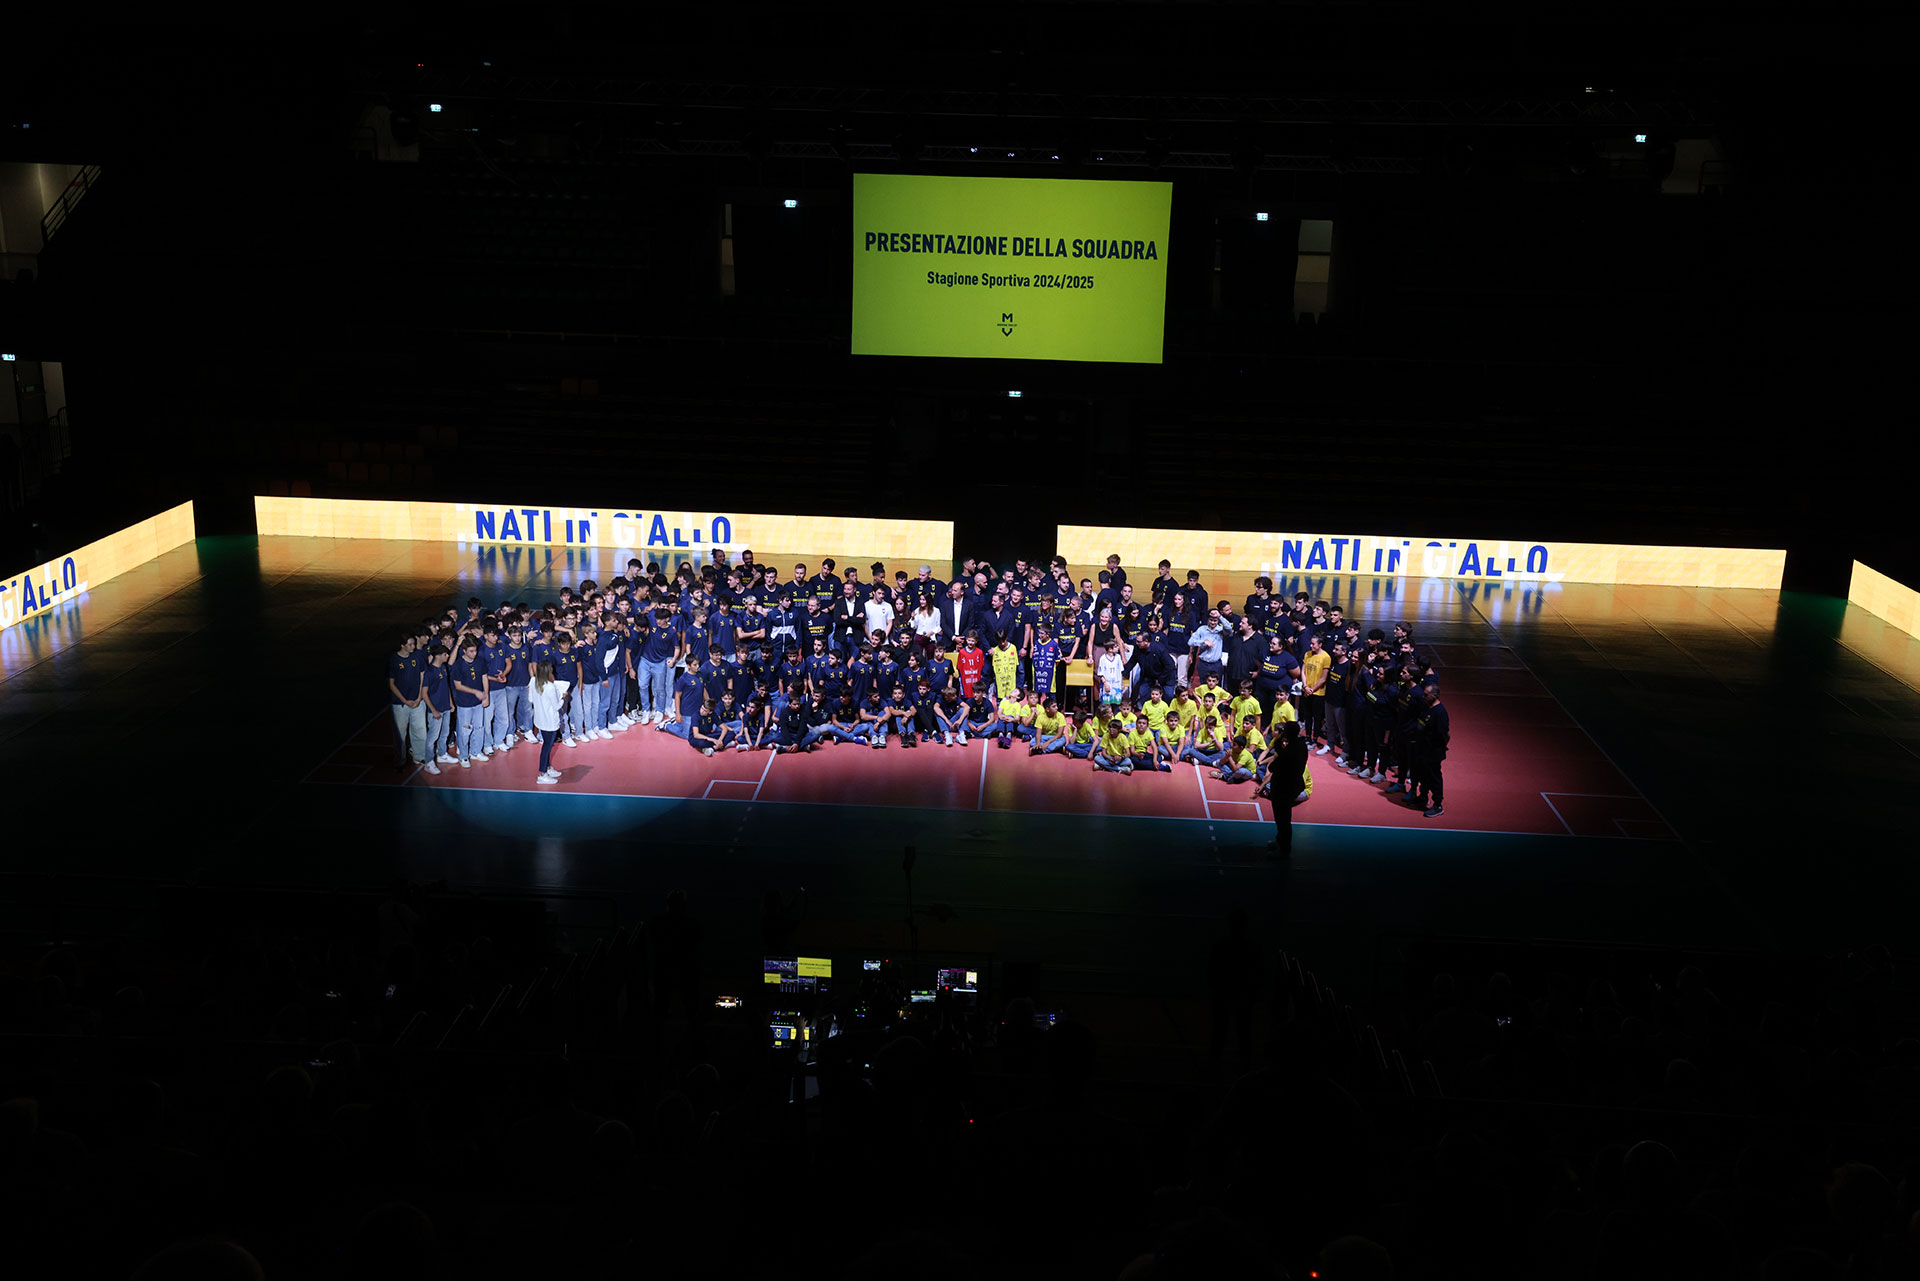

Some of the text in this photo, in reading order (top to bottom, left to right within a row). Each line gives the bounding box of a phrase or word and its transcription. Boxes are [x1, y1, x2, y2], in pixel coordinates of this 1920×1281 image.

[865, 232, 1158, 261] PRESENTAZIONE DELLA SQUADRA
[927, 271, 1094, 290] Stagione Sportiva 2024/2025
[475, 508, 551, 542] NATI
[1281, 537, 1361, 571] NATI
